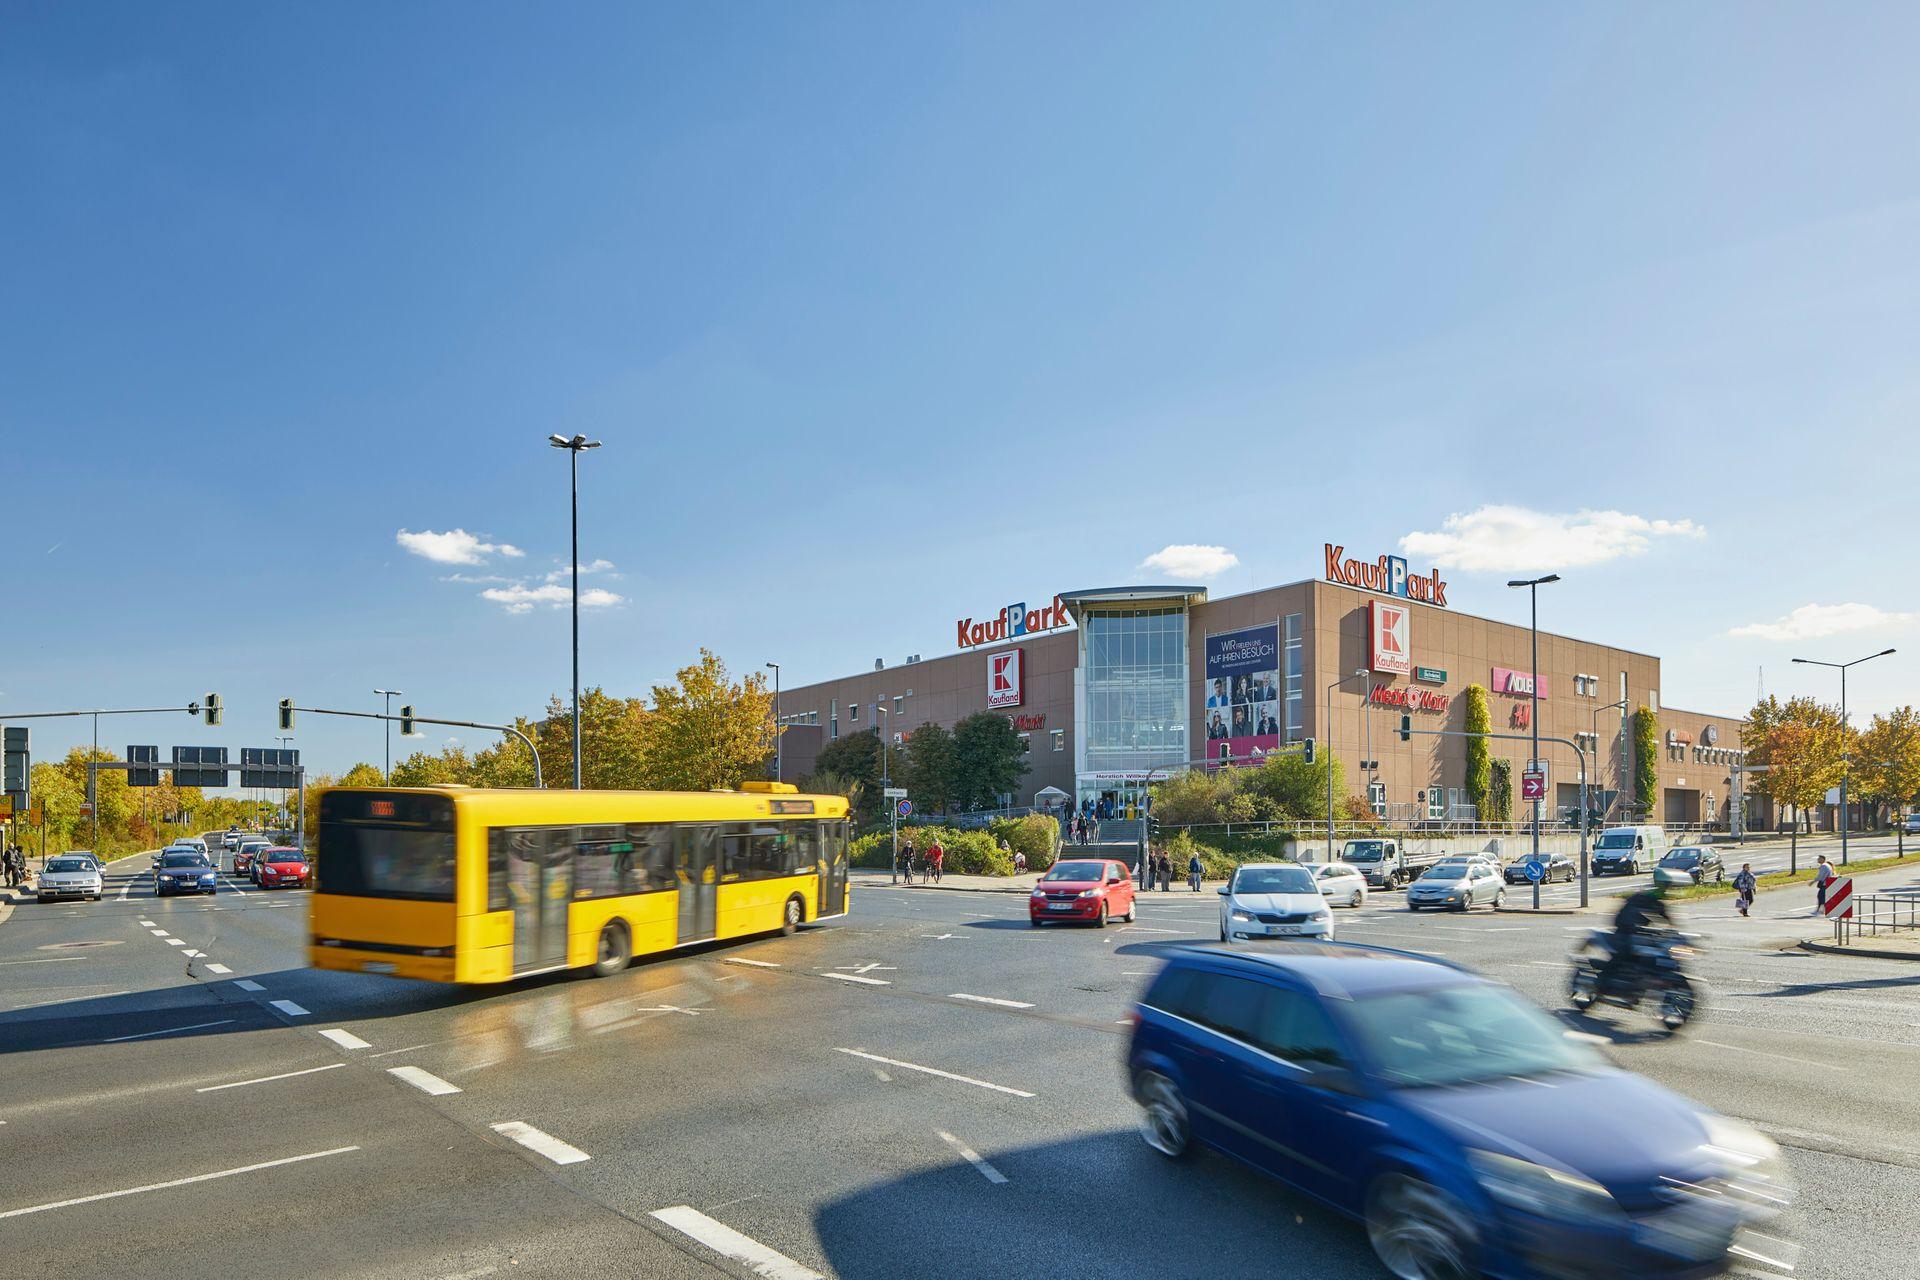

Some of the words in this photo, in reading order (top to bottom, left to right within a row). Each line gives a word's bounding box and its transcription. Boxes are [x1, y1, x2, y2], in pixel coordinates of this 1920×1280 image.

[1325, 543, 1447, 607] KaufPark
[957, 595, 1068, 648] KaufPark
[1209, 654, 1221, 664] AUF
[1222, 652, 1241, 662] IHREN
[1241, 644, 1274, 659] BESUCH
[1221, 640, 1236, 651] WIR
[1375, 654, 1409, 670] Kaufland
[1507, 672, 1534, 694] ADLE
[988, 692, 1019, 705] Kaufland
[1369, 683, 1408, 705] Media
[1420, 689, 1449, 711] Markt
